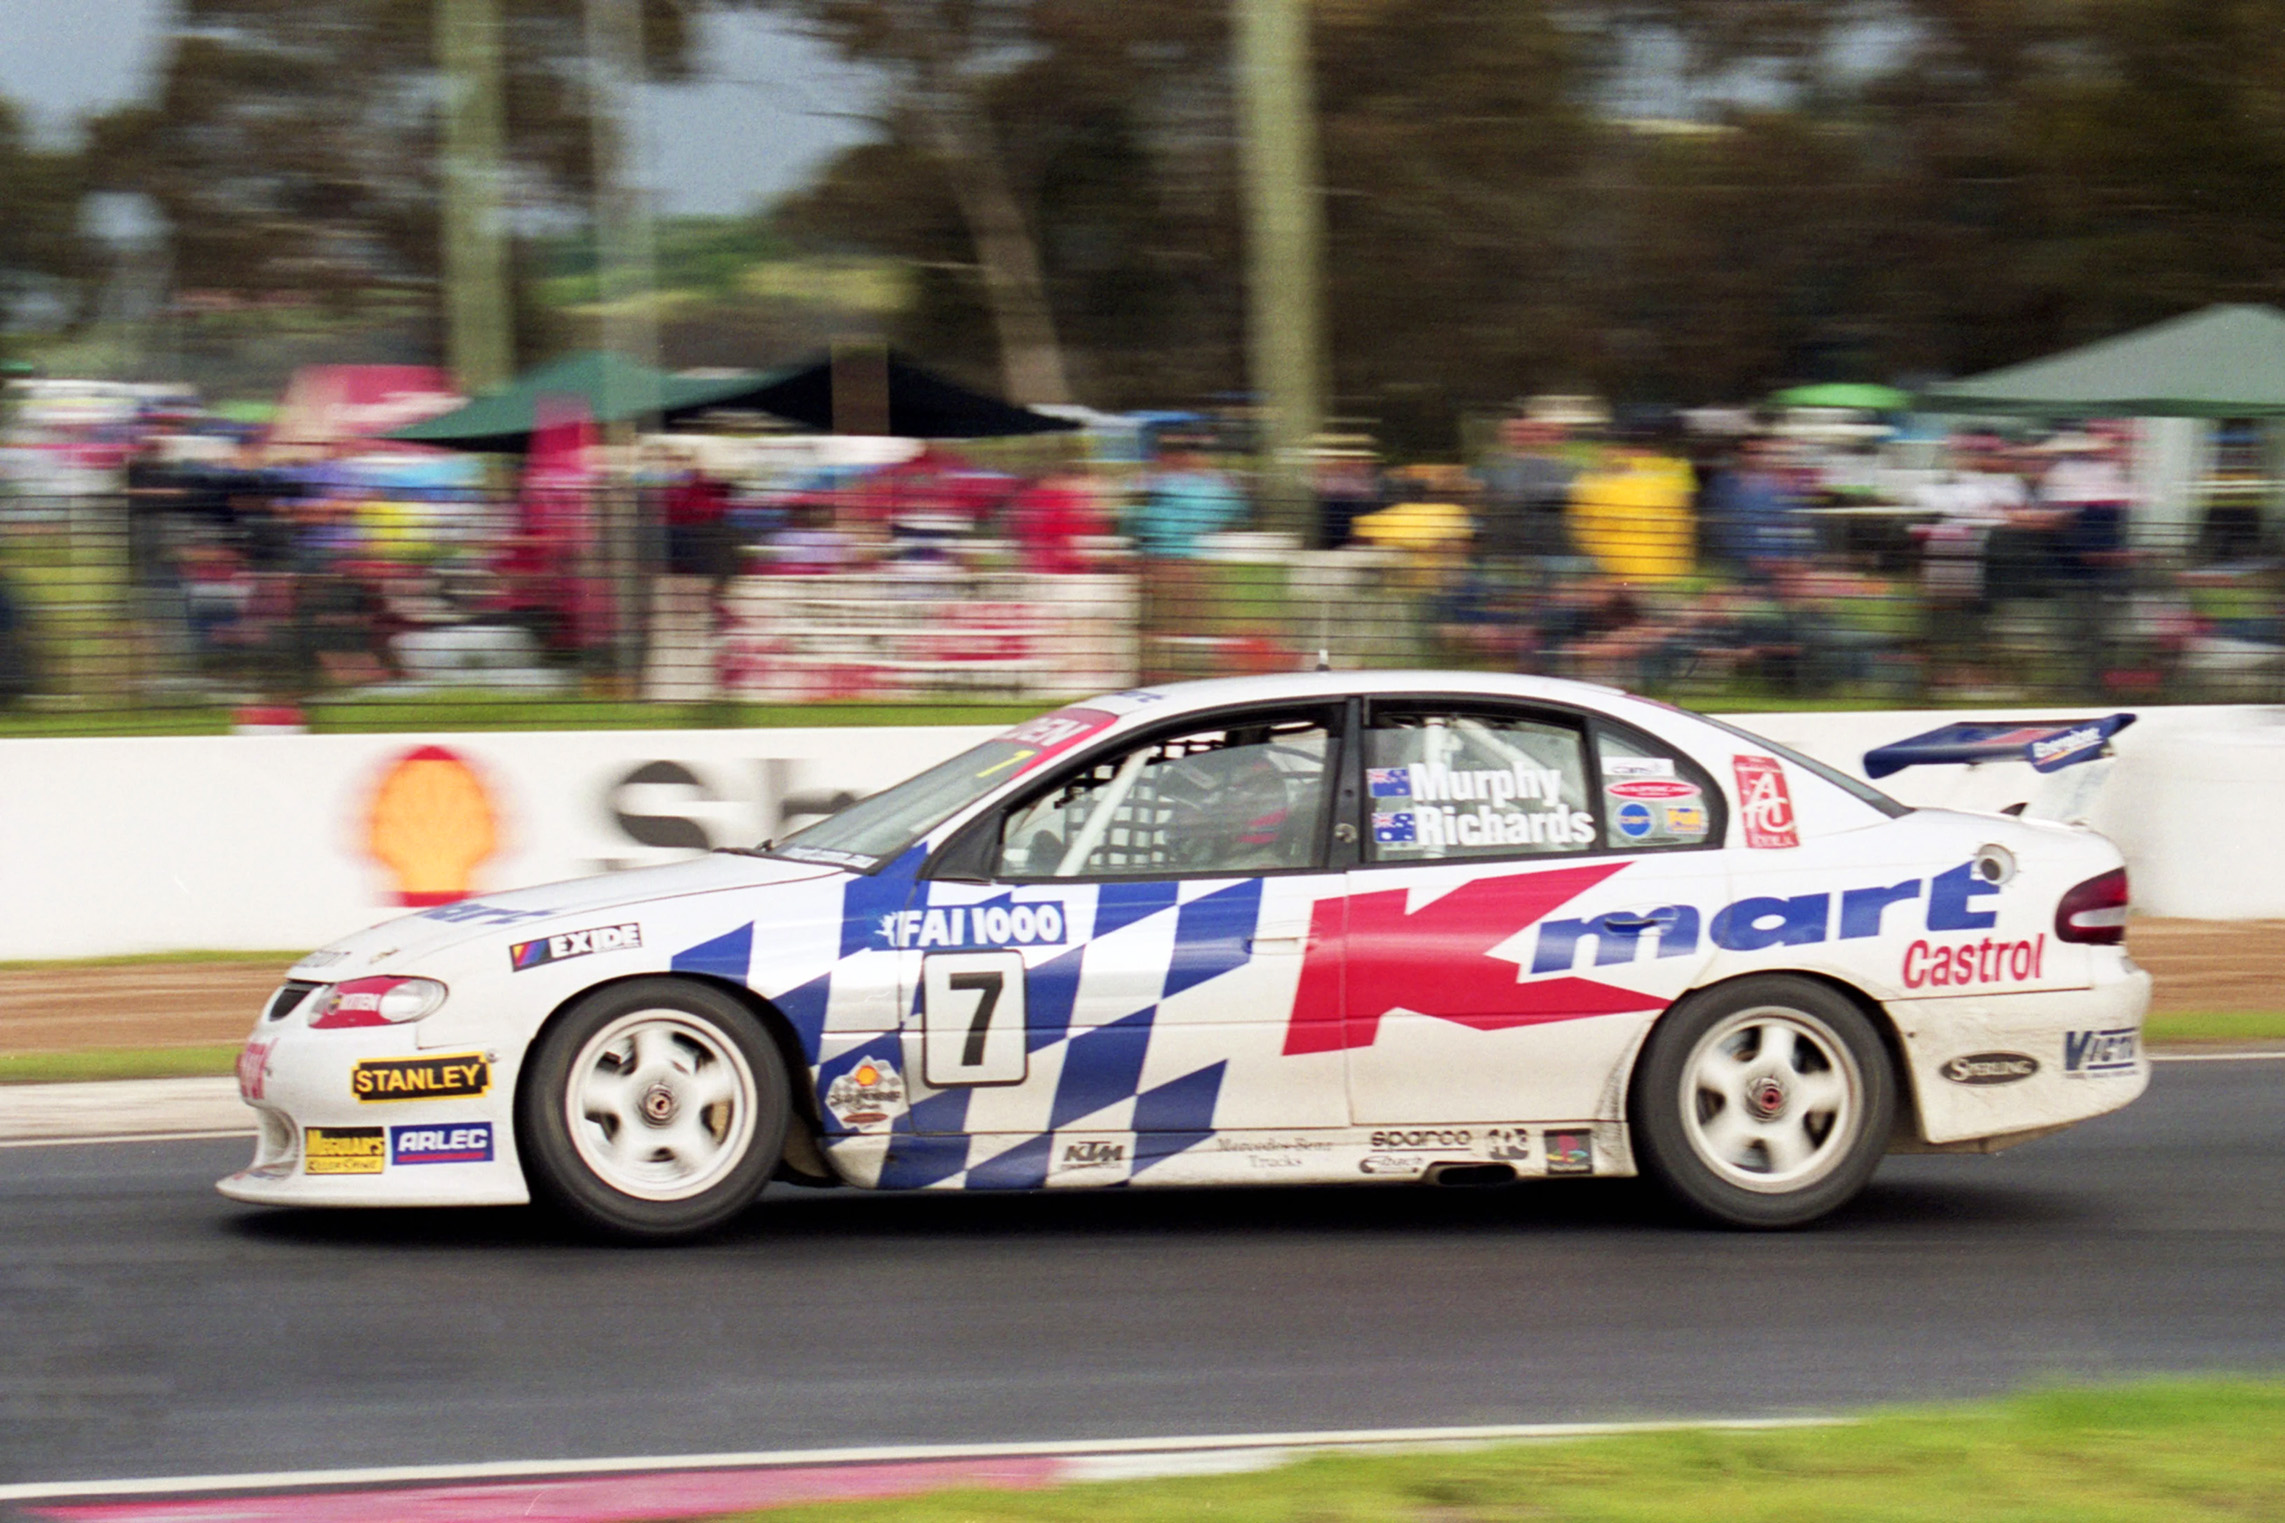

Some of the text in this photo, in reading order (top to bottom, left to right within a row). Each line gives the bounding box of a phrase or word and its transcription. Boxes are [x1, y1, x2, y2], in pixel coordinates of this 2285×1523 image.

[1408, 761, 1561, 807] Murphy
[1414, 803, 1596, 846] Richards
[550, 924, 640, 958] EXIDE
[899, 904, 1062, 947] FAI 1000
[1902, 933, 2046, 990] Castrol
[949, 971, 1004, 1066] 7
[356, 1064, 480, 1093] STANLEY
[398, 1128, 488, 1152] ARLEC
[1064, 1140, 1123, 1162] KTM
[1370, 1130, 1472, 1150] sparco
